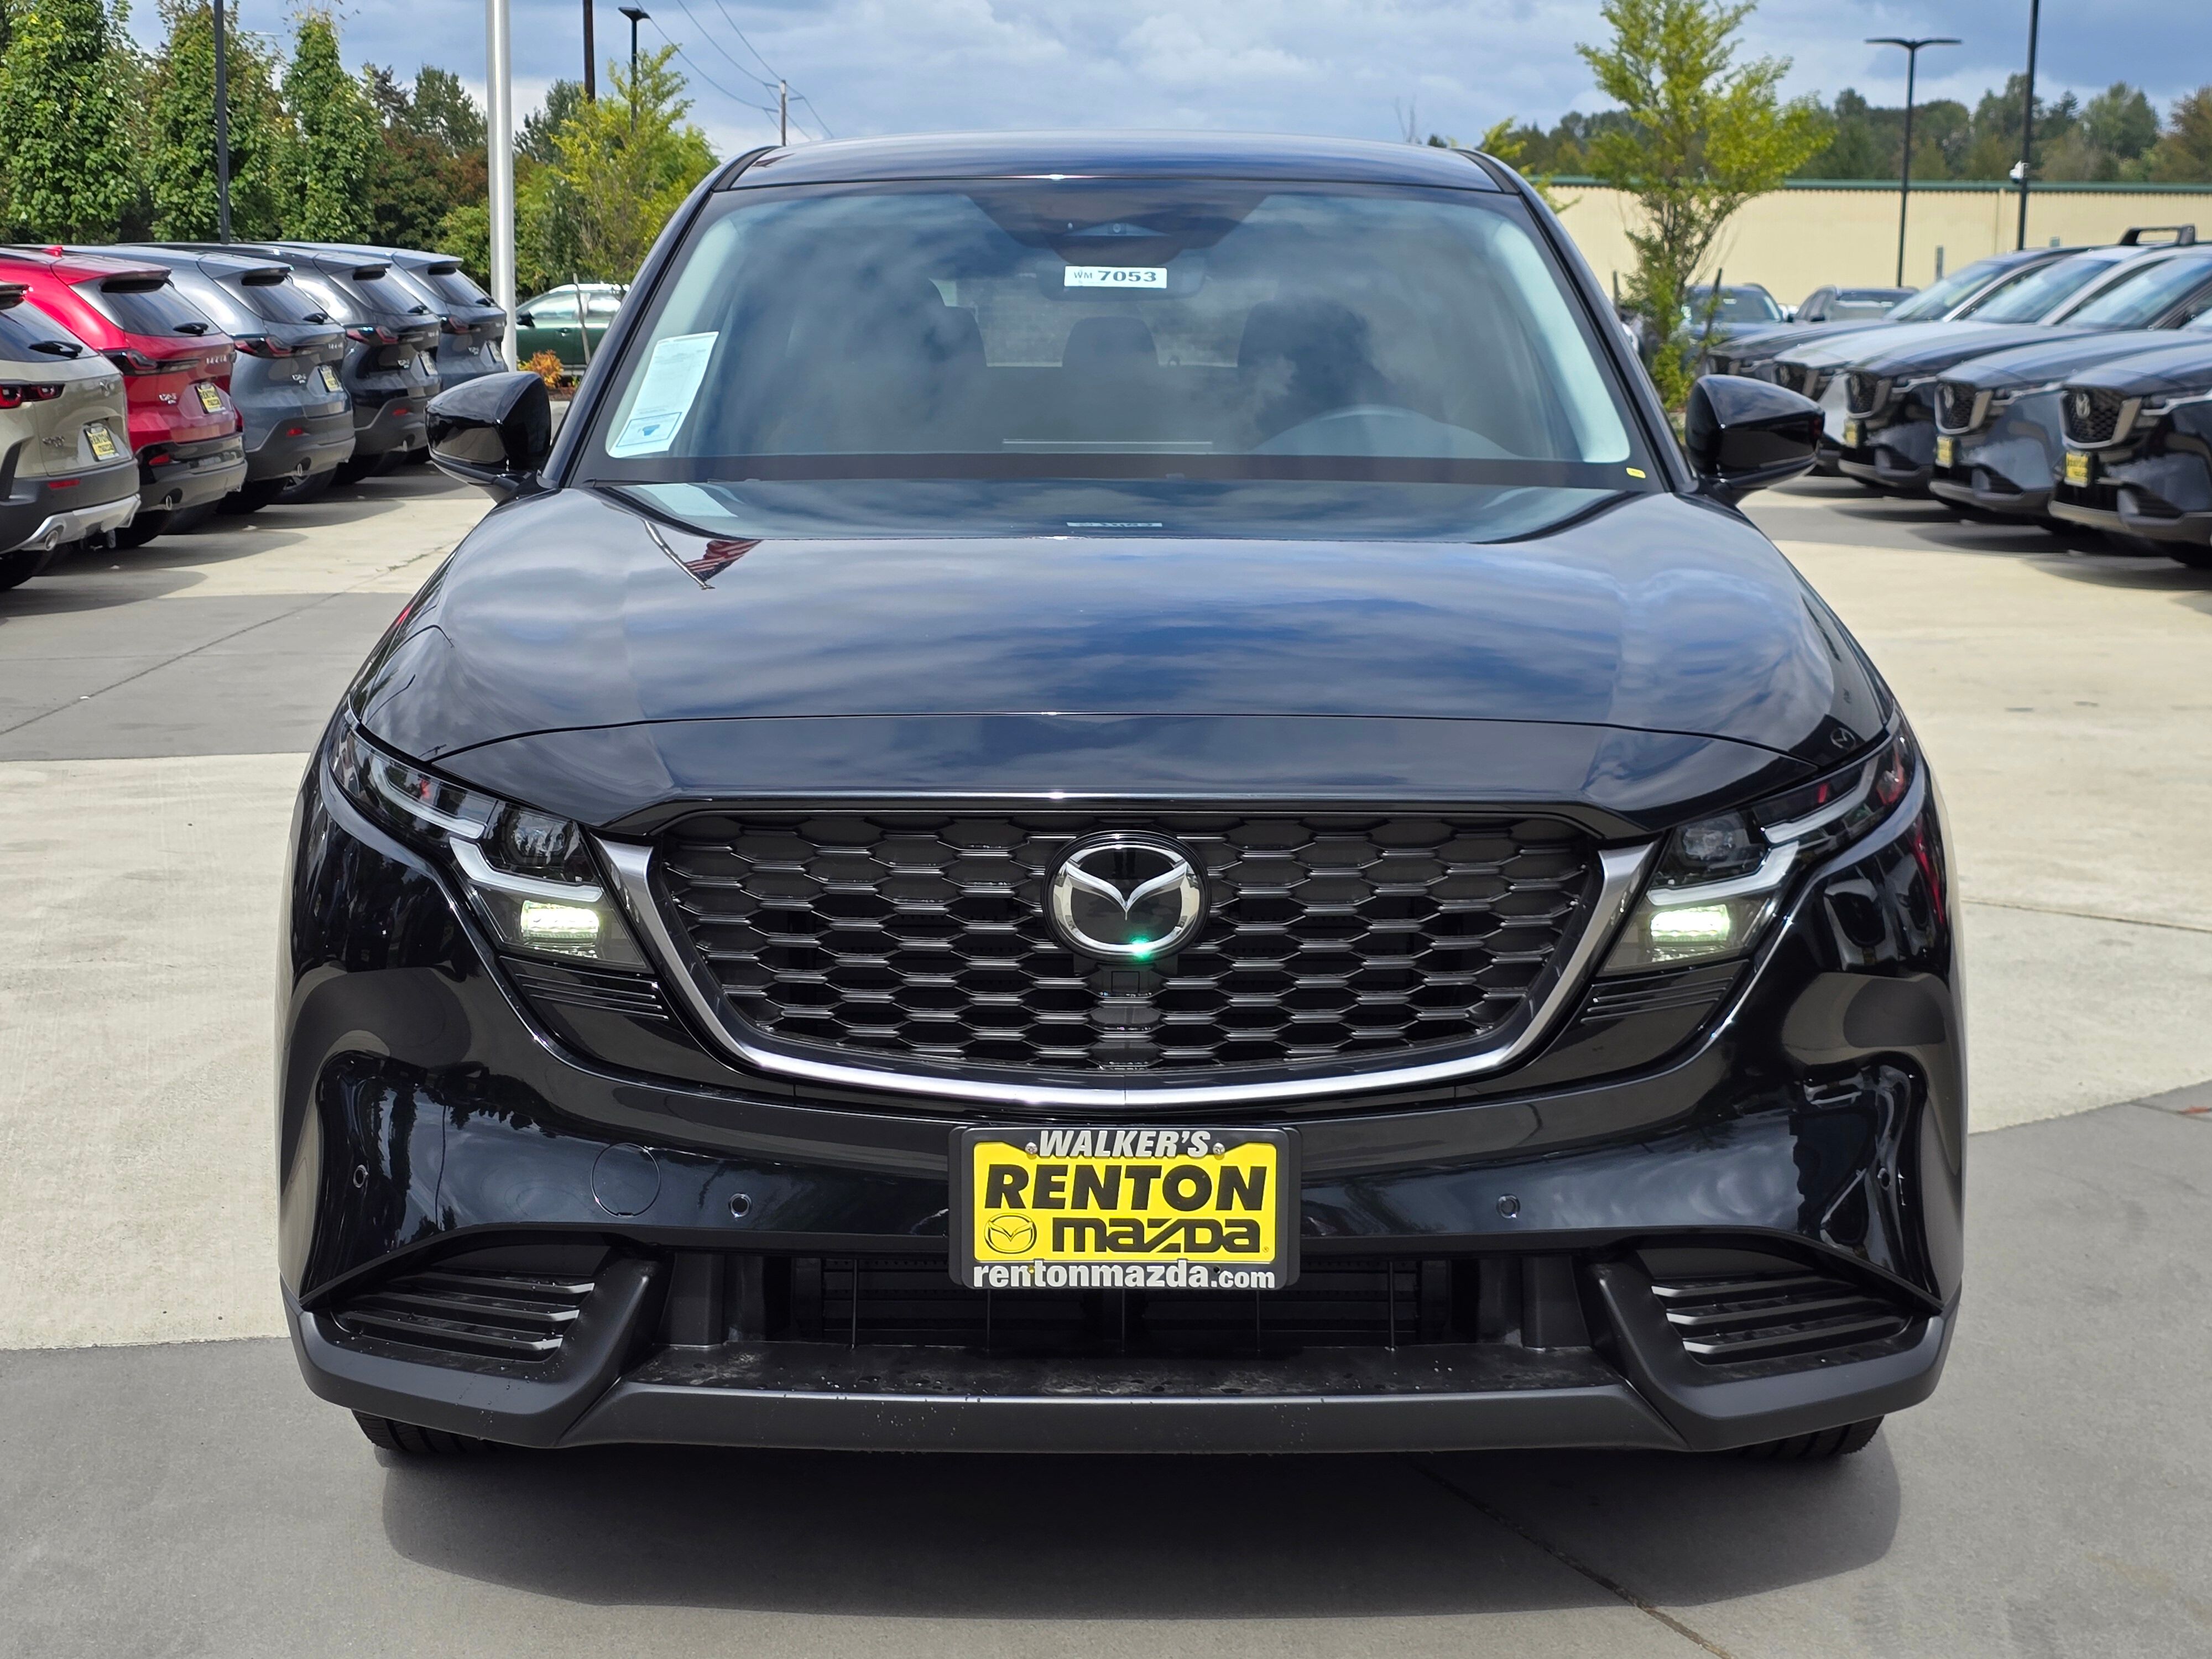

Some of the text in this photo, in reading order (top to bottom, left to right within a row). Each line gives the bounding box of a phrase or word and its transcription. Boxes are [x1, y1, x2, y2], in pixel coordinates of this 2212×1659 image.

[1098, 270, 1157, 283] 7053
[1039, 1130, 1211, 1157] WALKER'S
[984, 1164, 1267, 1211] RENTON
[973, 1260, 1275, 1288] rentonmazda.com
